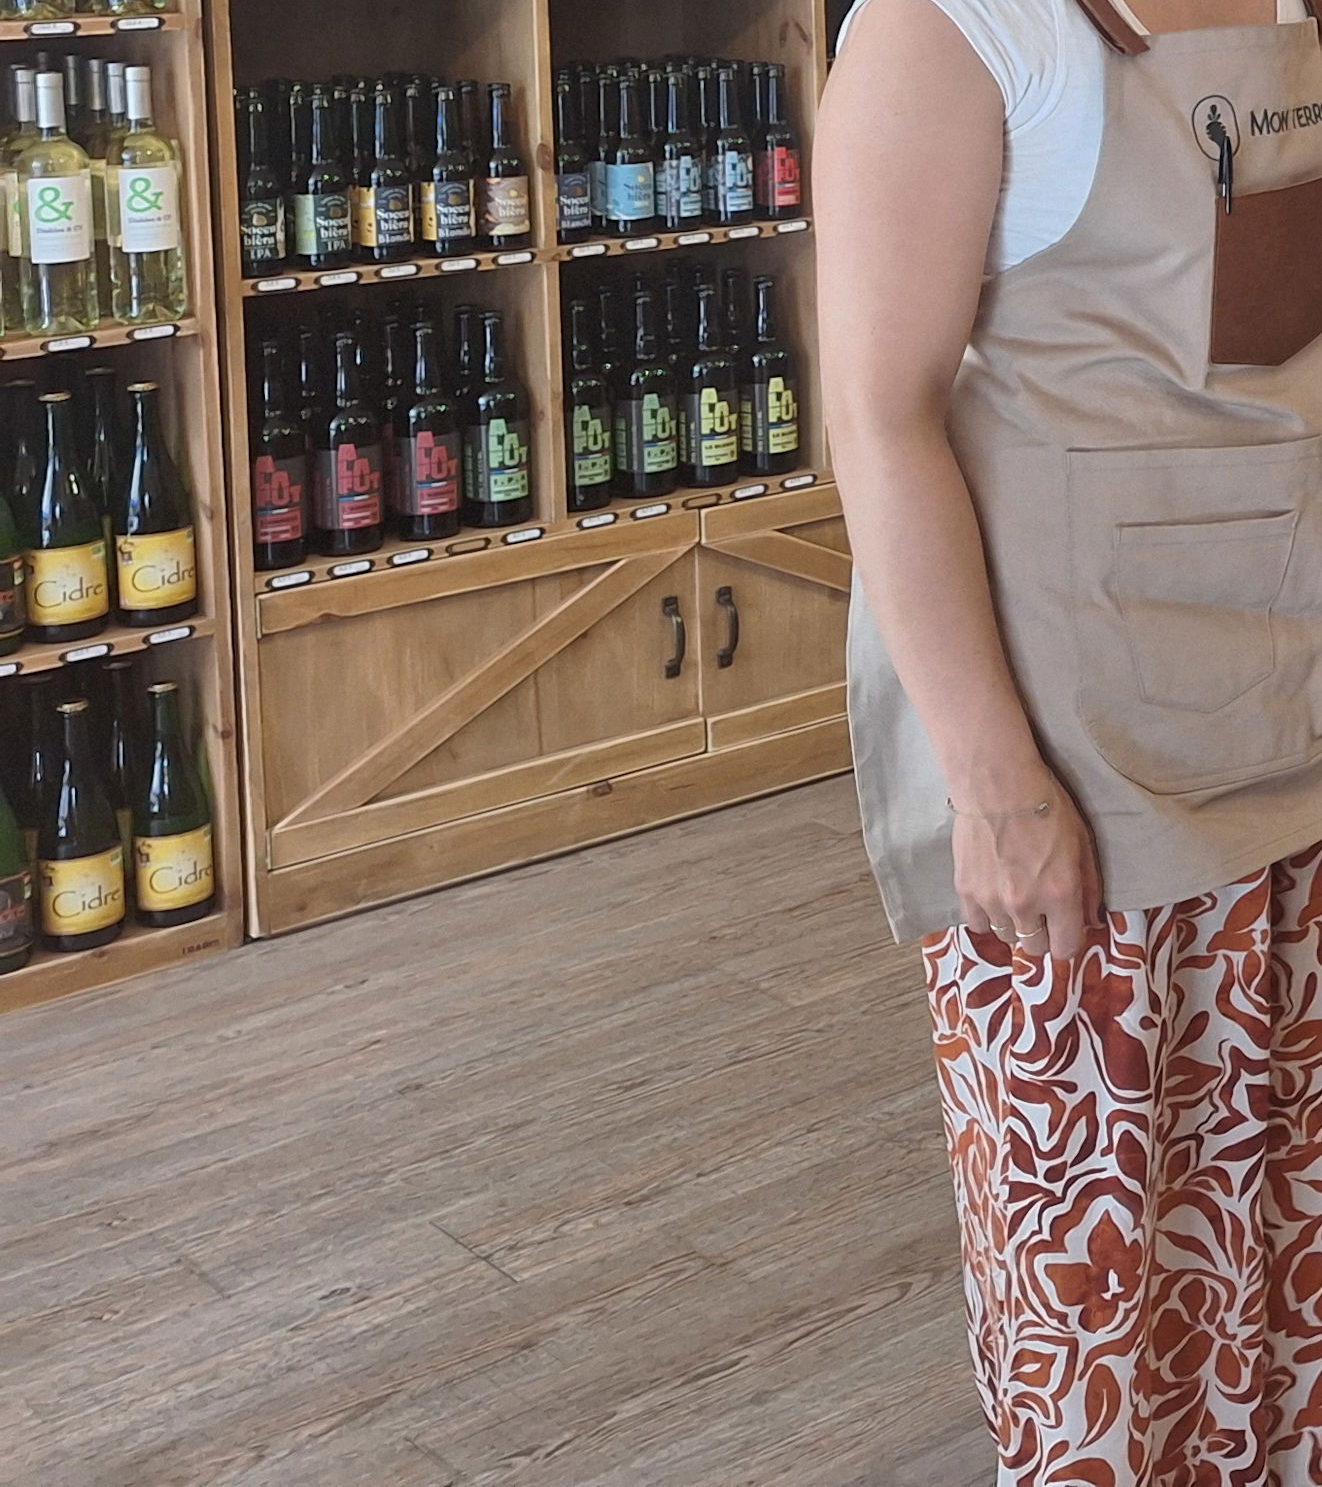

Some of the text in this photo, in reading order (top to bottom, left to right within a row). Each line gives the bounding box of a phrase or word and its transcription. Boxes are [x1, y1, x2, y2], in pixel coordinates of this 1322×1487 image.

[34, 575, 104, 609] Cidre
[131, 561, 195, 593] Cidre
[52, 884, 121, 919] Cidre
